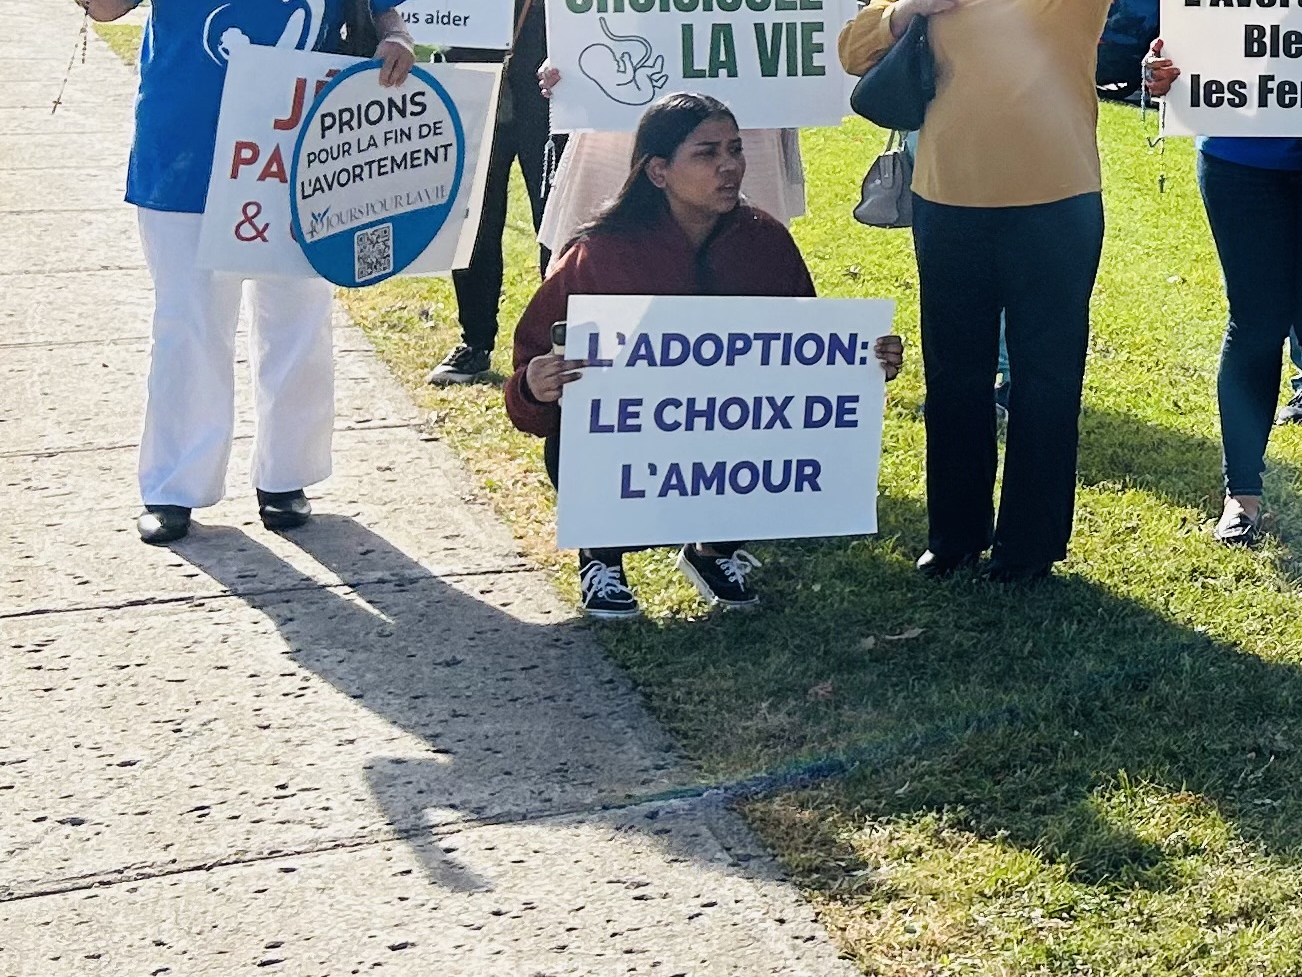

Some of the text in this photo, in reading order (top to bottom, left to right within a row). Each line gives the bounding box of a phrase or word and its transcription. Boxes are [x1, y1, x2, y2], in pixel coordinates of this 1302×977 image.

[424, 9, 470, 27] aider
[681, 21, 826, 79] LA VIE
[1190, 74, 1248, 108] les
[320, 90, 427, 139] PRIONS
[307, 120, 443, 169] POUR LA FIN DE
[300, 142, 453, 200] L'AVORTEMENT
[234, 201, 270, 243] &
[587, 331, 870, 368] L'ADOPTION:
[588, 394, 860, 434] LE CHOIX DE
[620, 458, 822, 499] L'AMOUR
